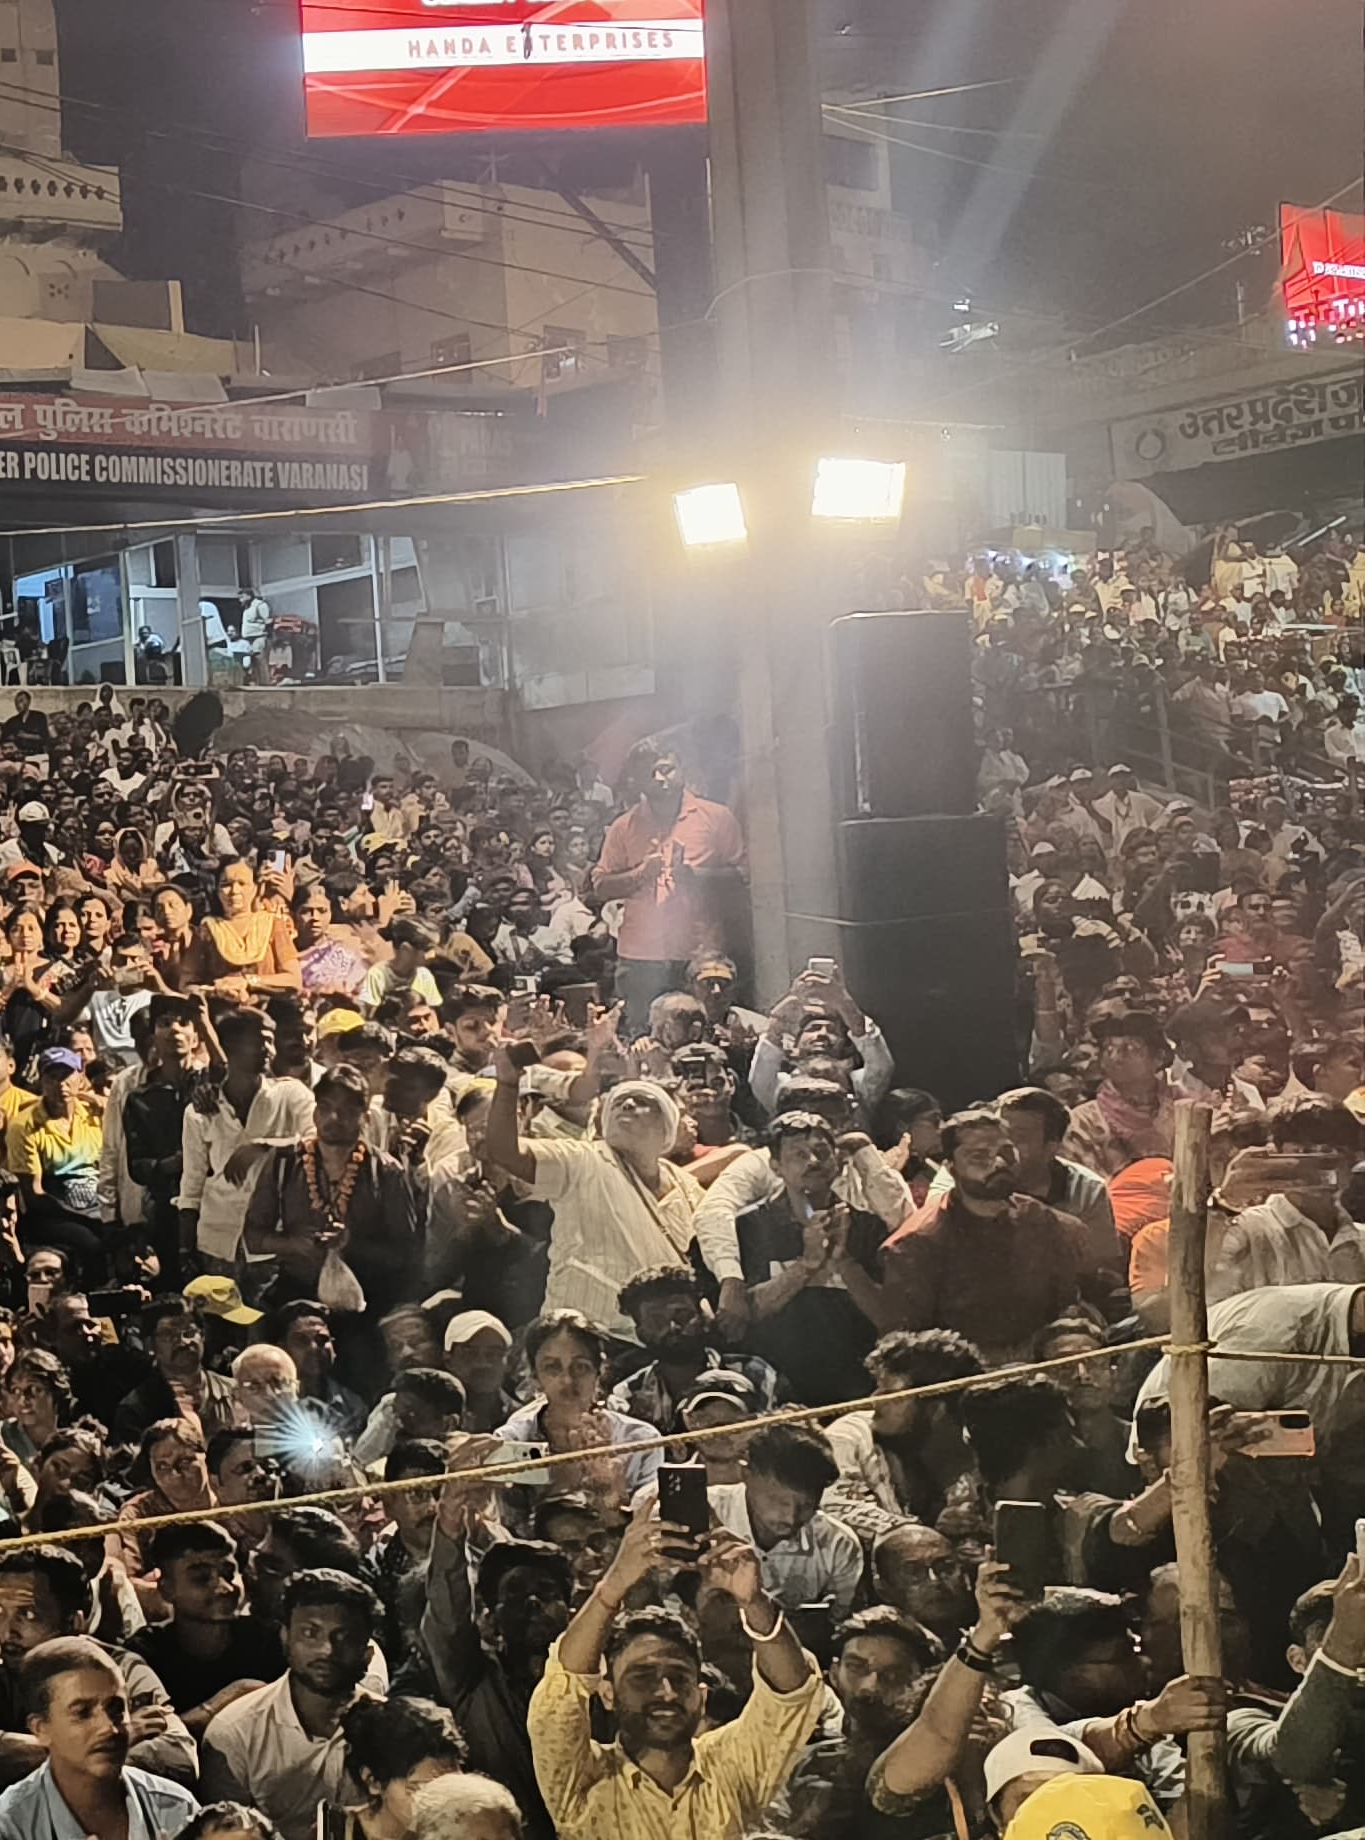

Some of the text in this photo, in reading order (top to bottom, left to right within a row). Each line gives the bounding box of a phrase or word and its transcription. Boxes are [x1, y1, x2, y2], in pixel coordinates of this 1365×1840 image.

[407, 31, 675, 59] HANDA ETERPRISES
[33, 397, 115, 441] पुलिस
[252, 411, 358, 445] वाराणसी
[23, 451, 91, 482] POLICE
[94, 454, 275, 489] COMMISSIONERATE
[276, 461, 369, 492] VARANASI
